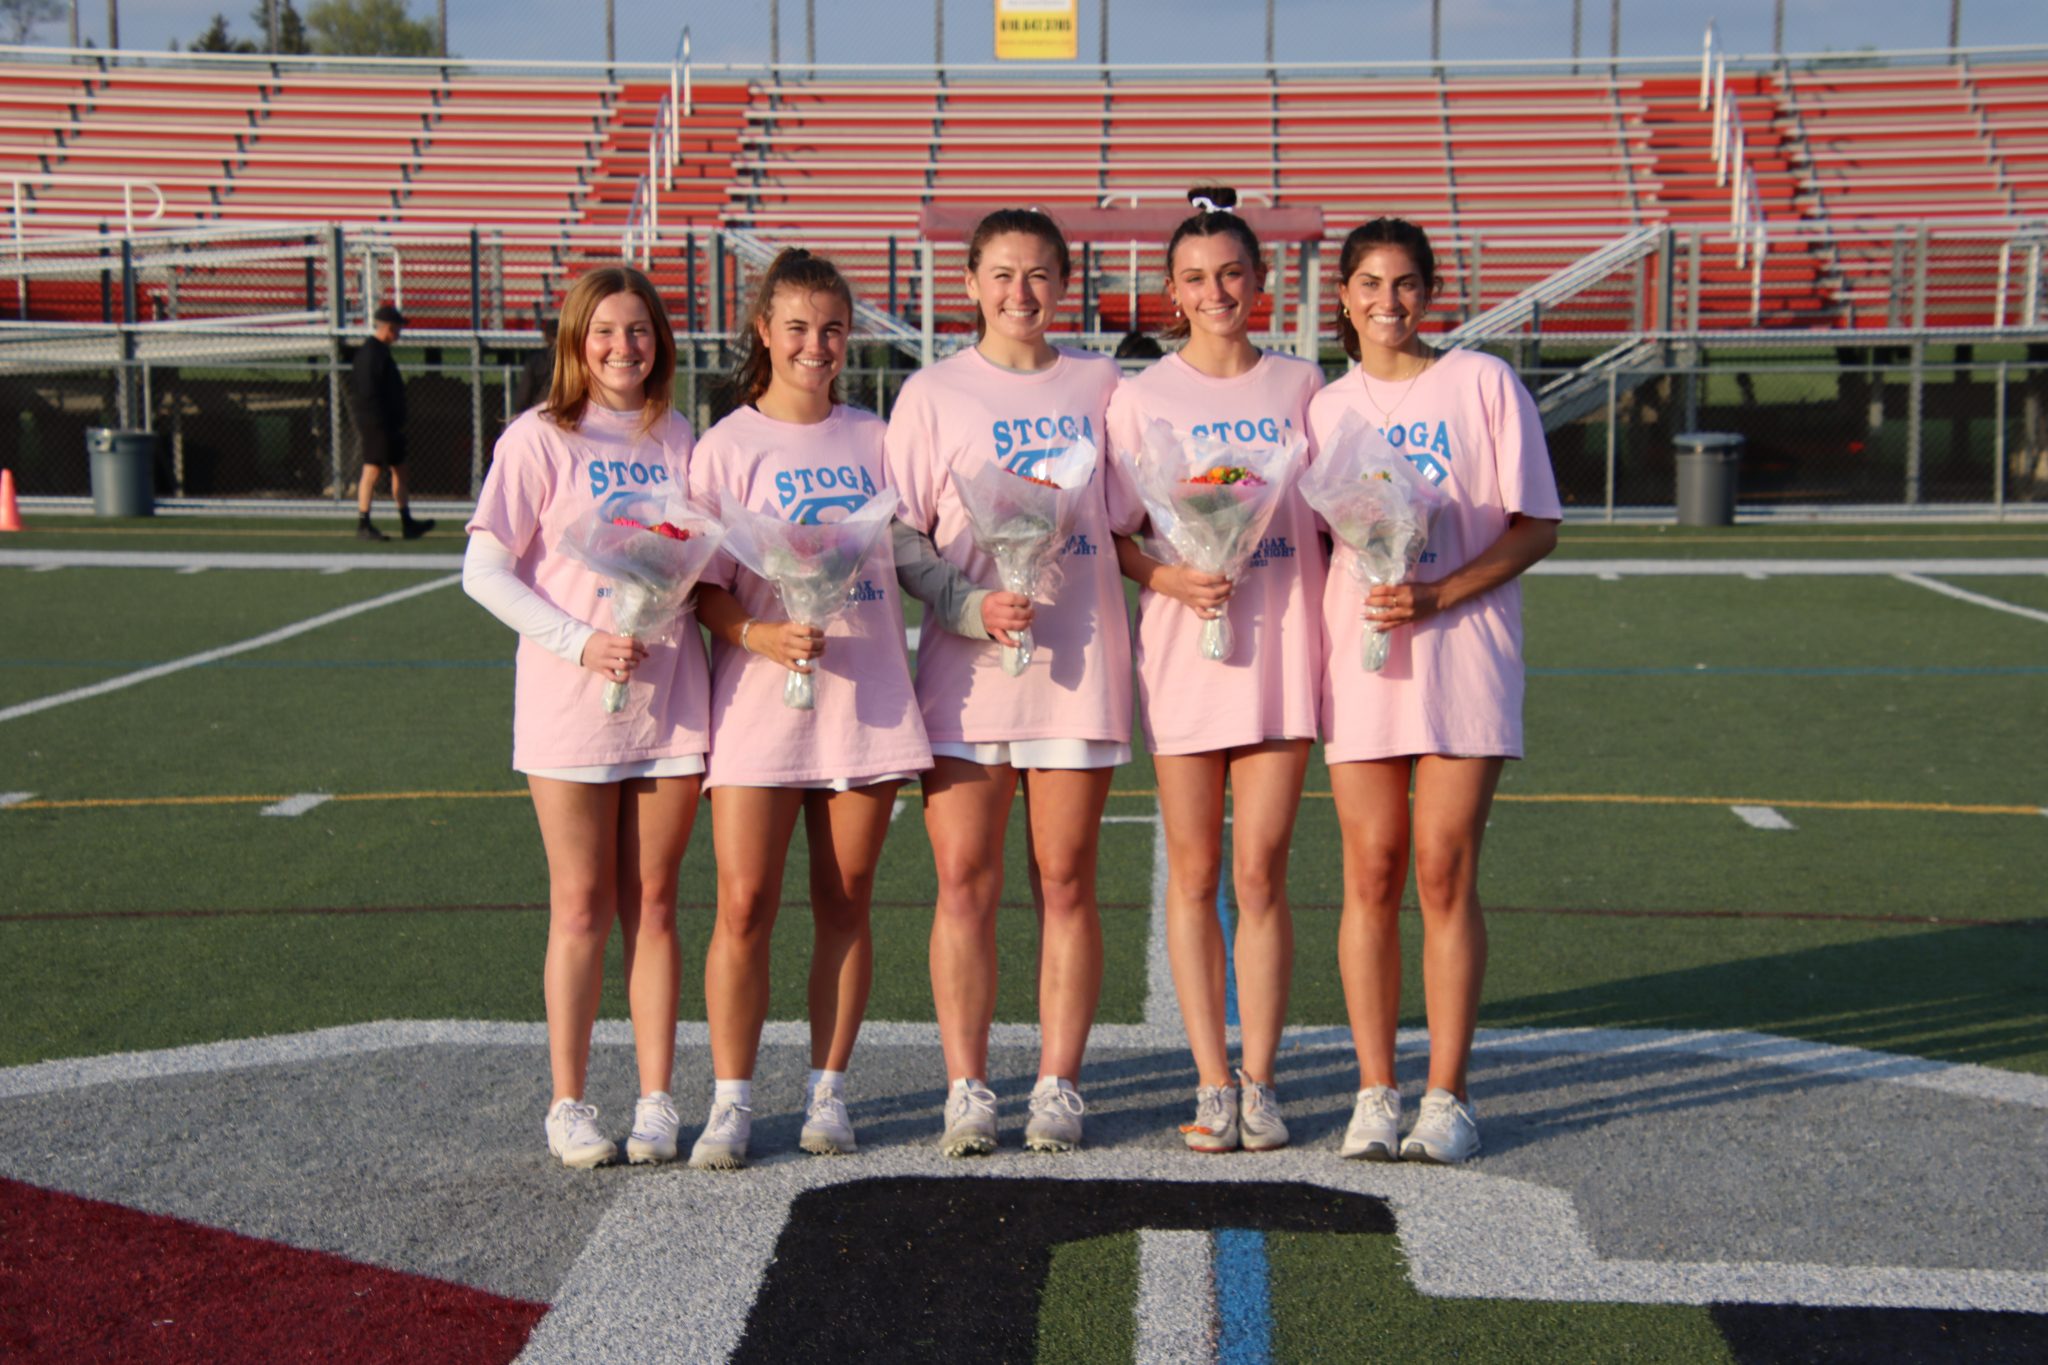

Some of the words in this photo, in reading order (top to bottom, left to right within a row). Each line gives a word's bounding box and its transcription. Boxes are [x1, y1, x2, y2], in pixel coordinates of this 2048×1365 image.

[993, 415, 1095, 460] STOGA
[1378, 420, 1452, 461] OGA
[589, 460, 669, 498] STOG
[775, 465, 878, 509] STOGA
